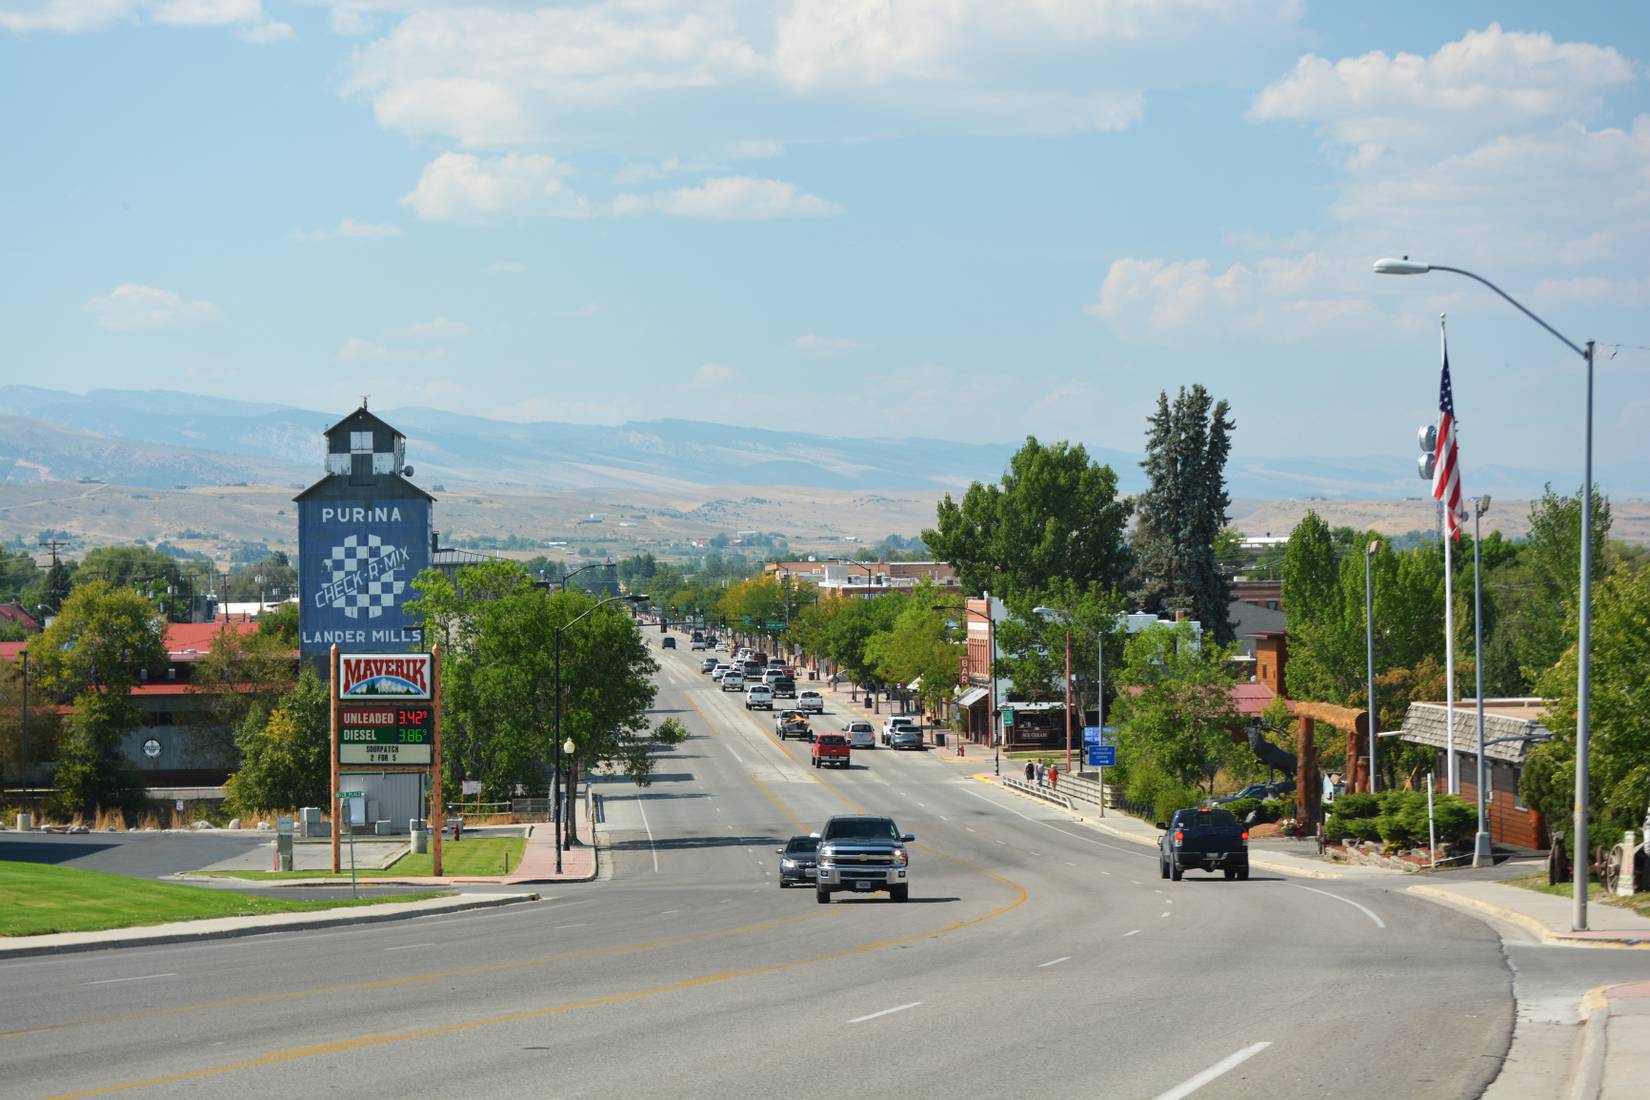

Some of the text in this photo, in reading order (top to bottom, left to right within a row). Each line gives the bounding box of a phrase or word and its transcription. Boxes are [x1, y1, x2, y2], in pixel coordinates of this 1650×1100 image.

[322, 507, 402, 523] PURINA
[302, 629, 422, 644] LANDER MILLS
[343, 658, 427, 695] MAVERIK
[343, 712, 394, 724] UNLEADED
[343, 729, 377, 741] DIESEL
